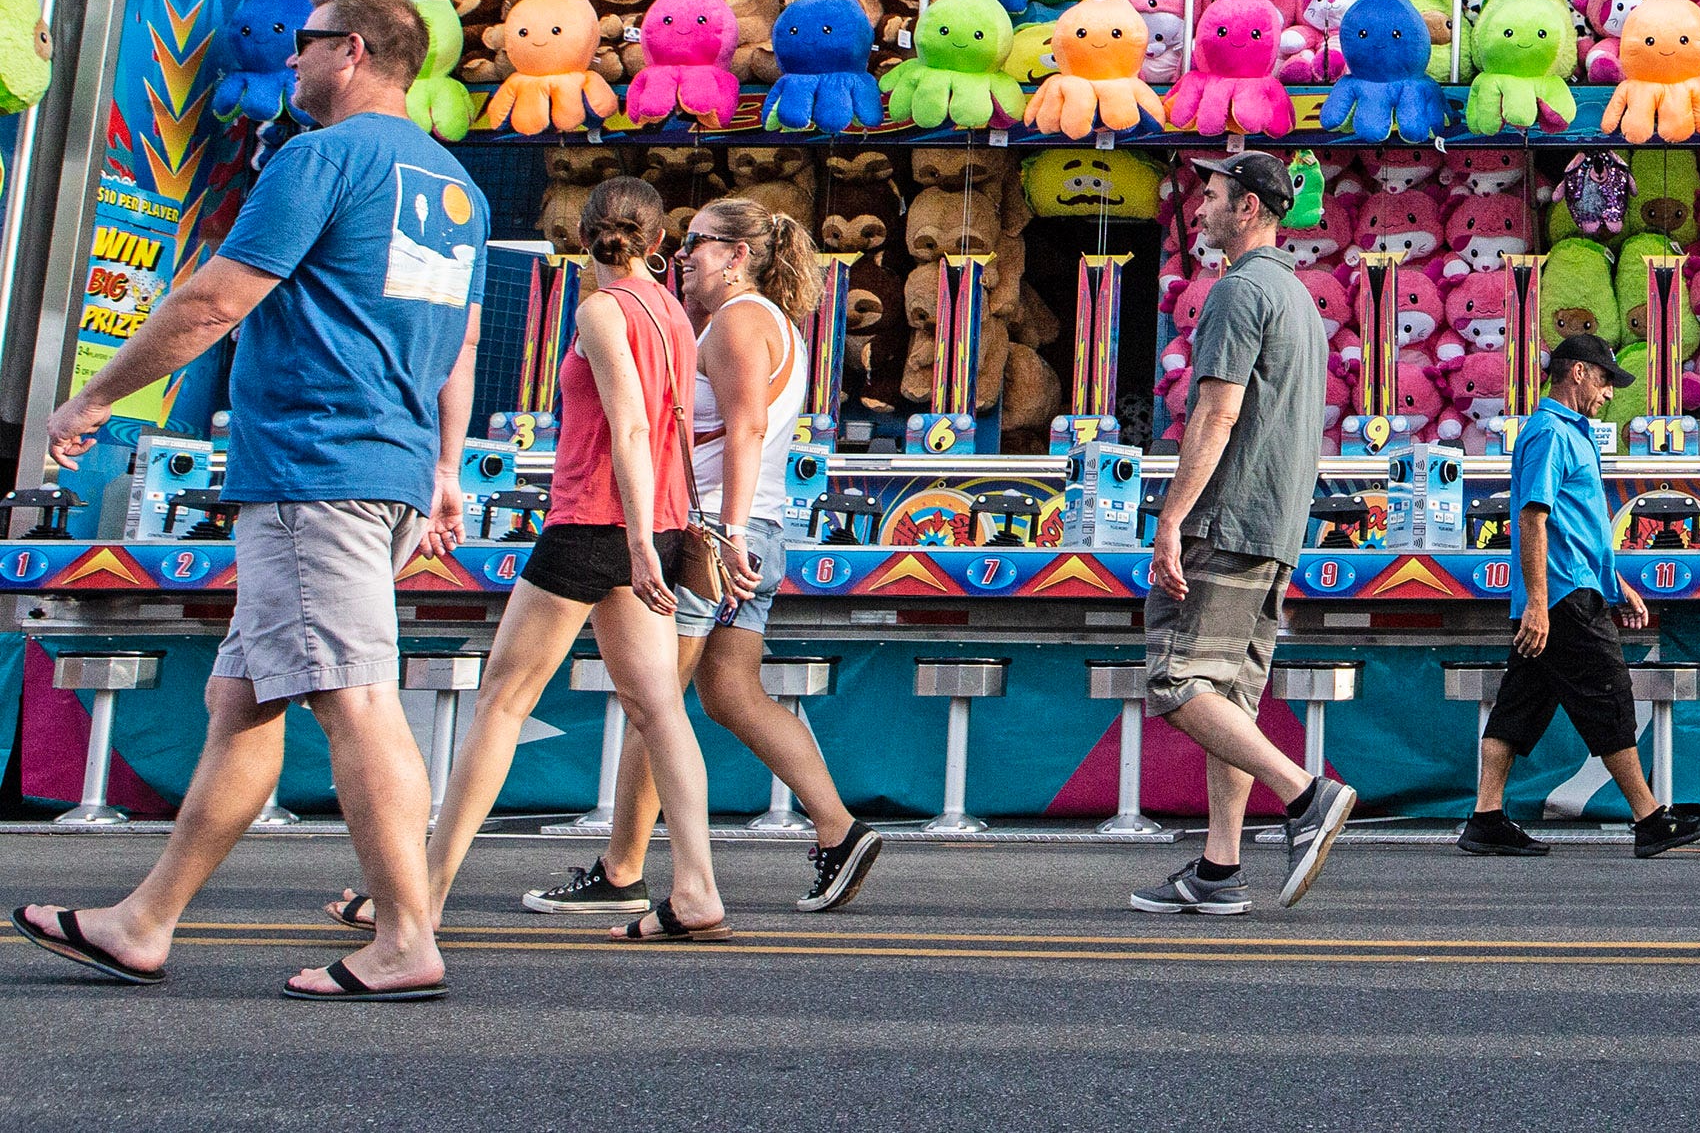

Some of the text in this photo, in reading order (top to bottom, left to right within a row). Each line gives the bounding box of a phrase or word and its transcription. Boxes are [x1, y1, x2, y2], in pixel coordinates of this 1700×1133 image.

[97, 186, 180, 223] $10 PER PLAYER
[92, 226, 164, 270] WIN
[87, 266, 129, 302] BIG
[79, 304, 150, 340] PRIZE
[511, 414, 536, 450] 3
[934, 417, 958, 452] 6
[1073, 418, 1100, 444] 7
[1366, 417, 1391, 454] 9
[1647, 418, 1685, 453] 11
[15, 552, 29, 577] 1
[174, 552, 192, 578] 2
[498, 554, 516, 580] 4
[816, 557, 835, 583] 6
[983, 558, 1000, 584] 7
[1321, 562, 1338, 588] 9
[1485, 561, 1510, 587] 10
[1656, 562, 1677, 587] 11
